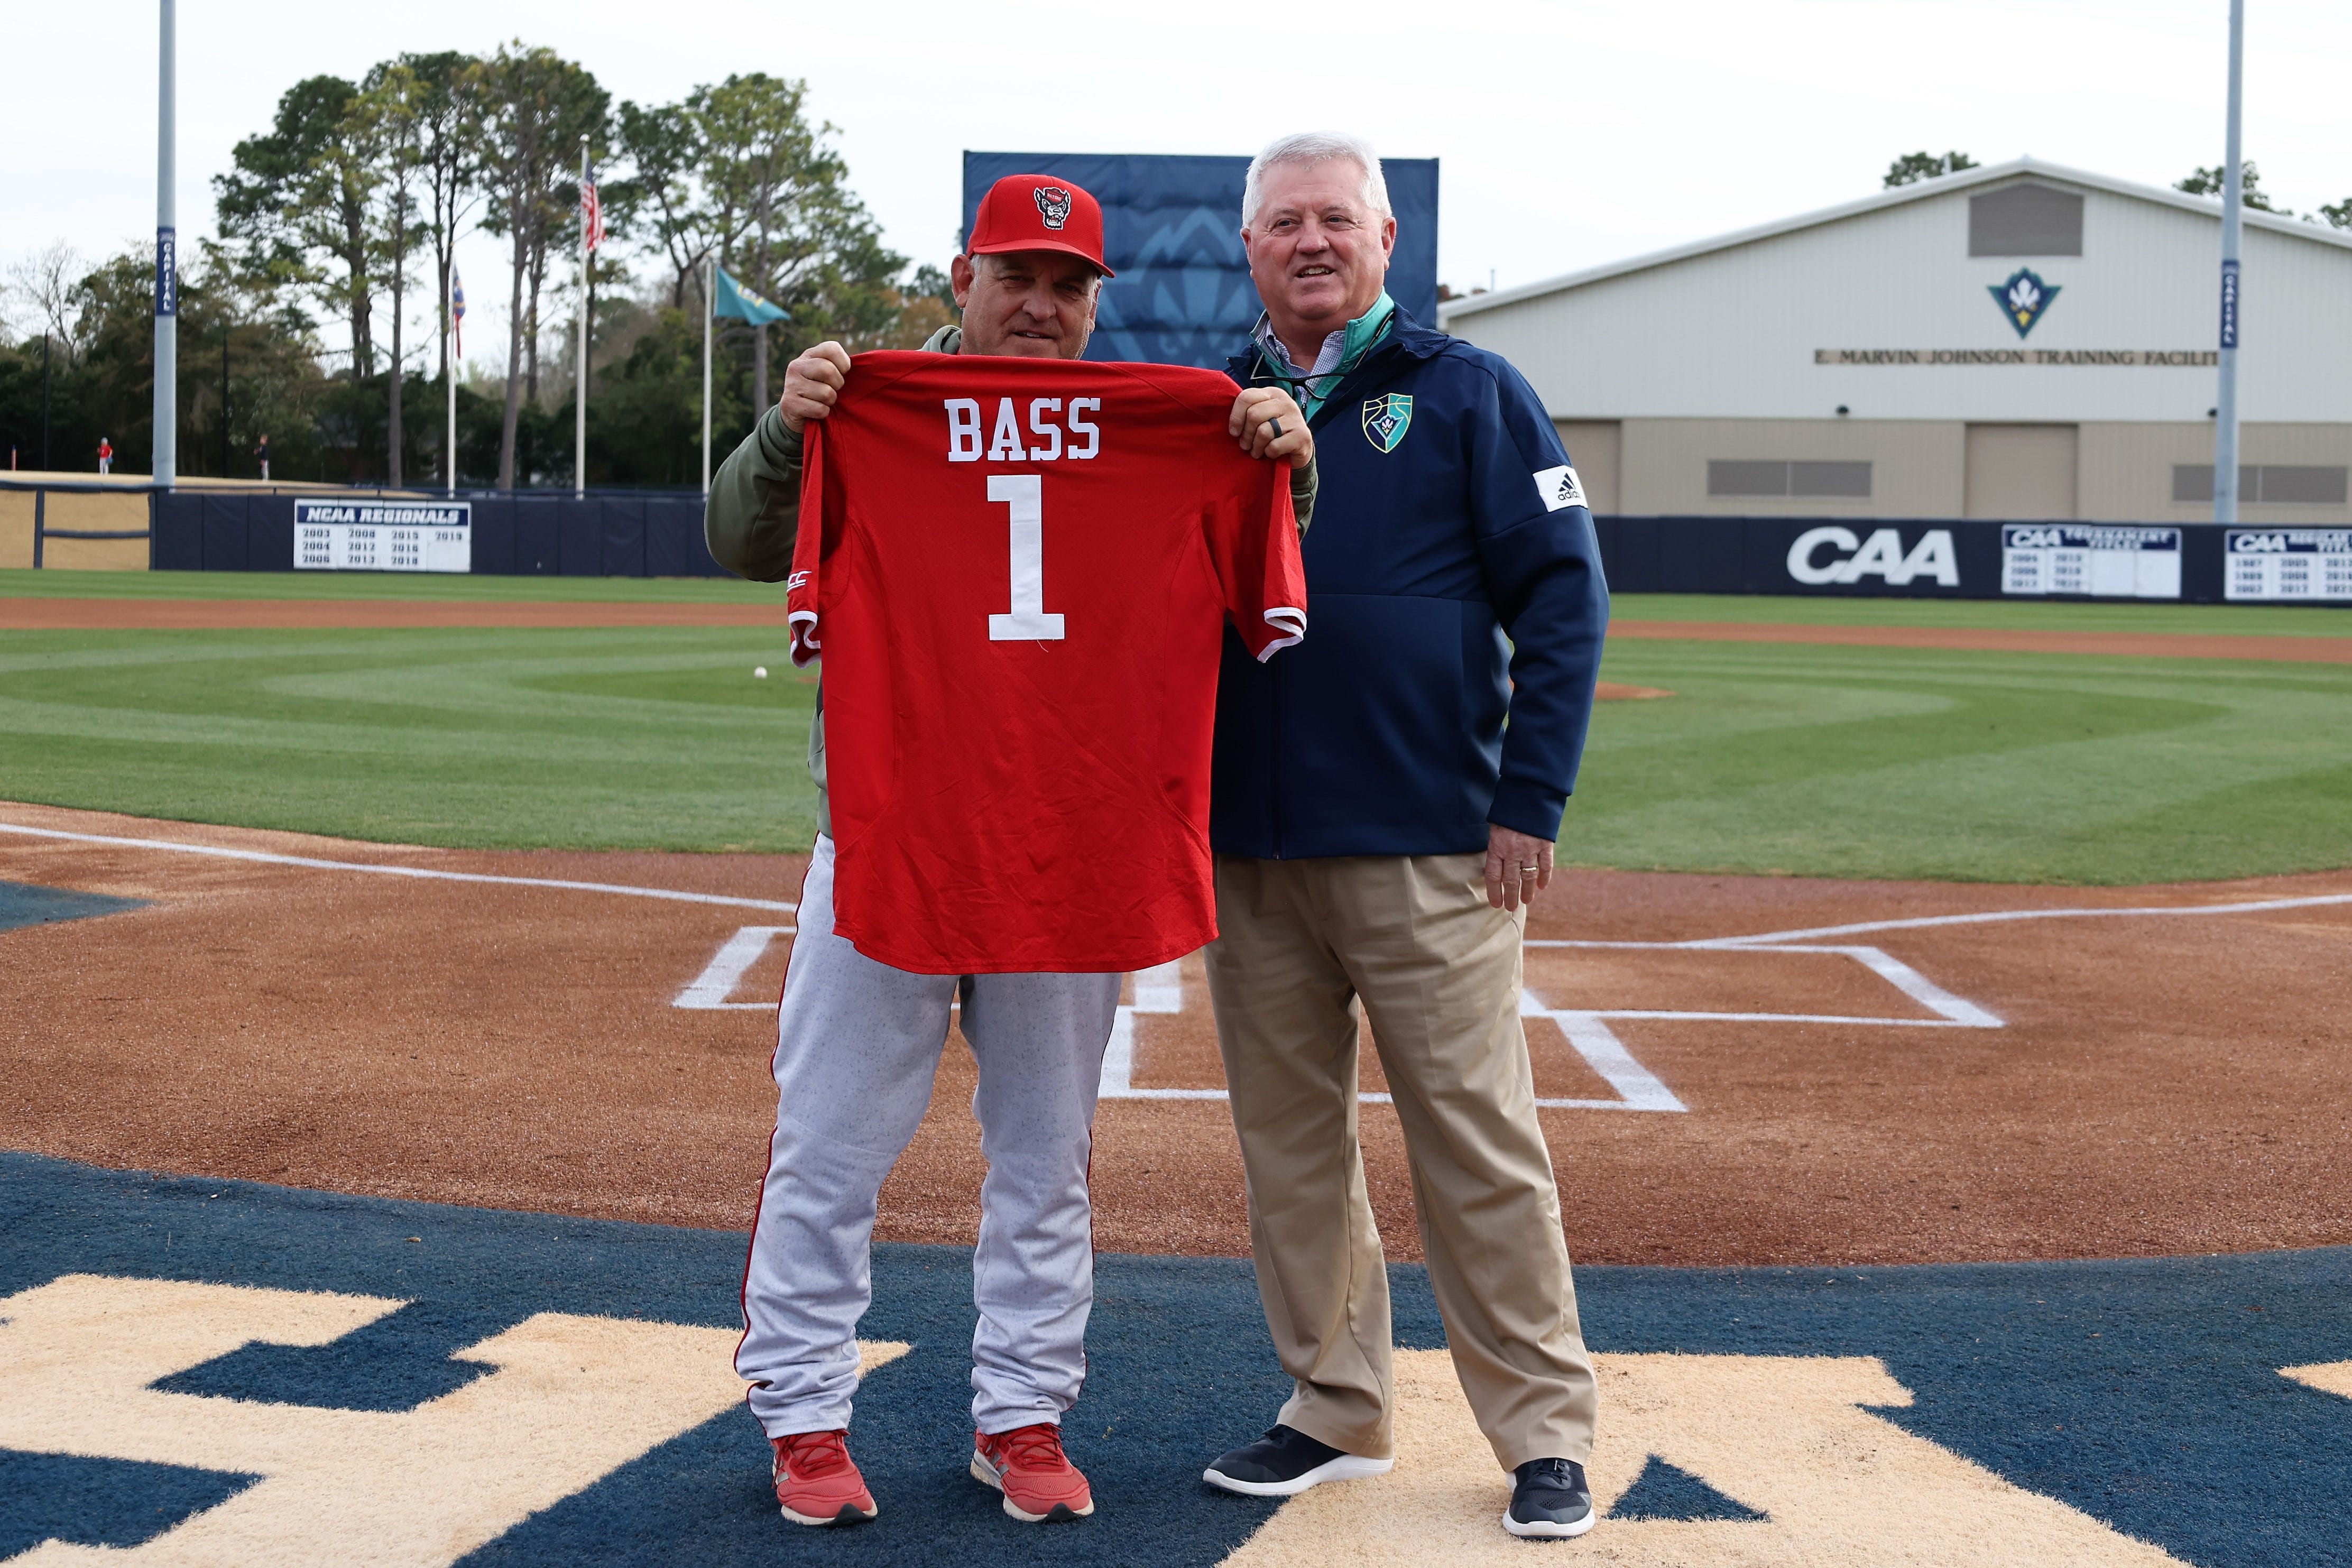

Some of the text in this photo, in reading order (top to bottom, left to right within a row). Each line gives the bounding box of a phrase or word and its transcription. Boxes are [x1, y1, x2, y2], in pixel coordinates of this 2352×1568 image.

[2224, 275, 2235, 343] CAPITAL
[1839, 349, 1918, 365] MARVIN
[1929, 349, 2026, 365] JOHNSON
[2034, 350, 2135, 366] TRAINING
[2144, 351, 2219, 366] FACILIT
[944, 398, 1101, 462] BASS
[306, 506, 460, 524] NCAA REGIONALS
[348, 542, 375, 550] 2012
[2010, 529, 2062, 547] CAA
[2234, 533, 2287, 552] CAA
[987, 474, 1065, 641] 1
[1787, 526, 1960, 586] CAA
